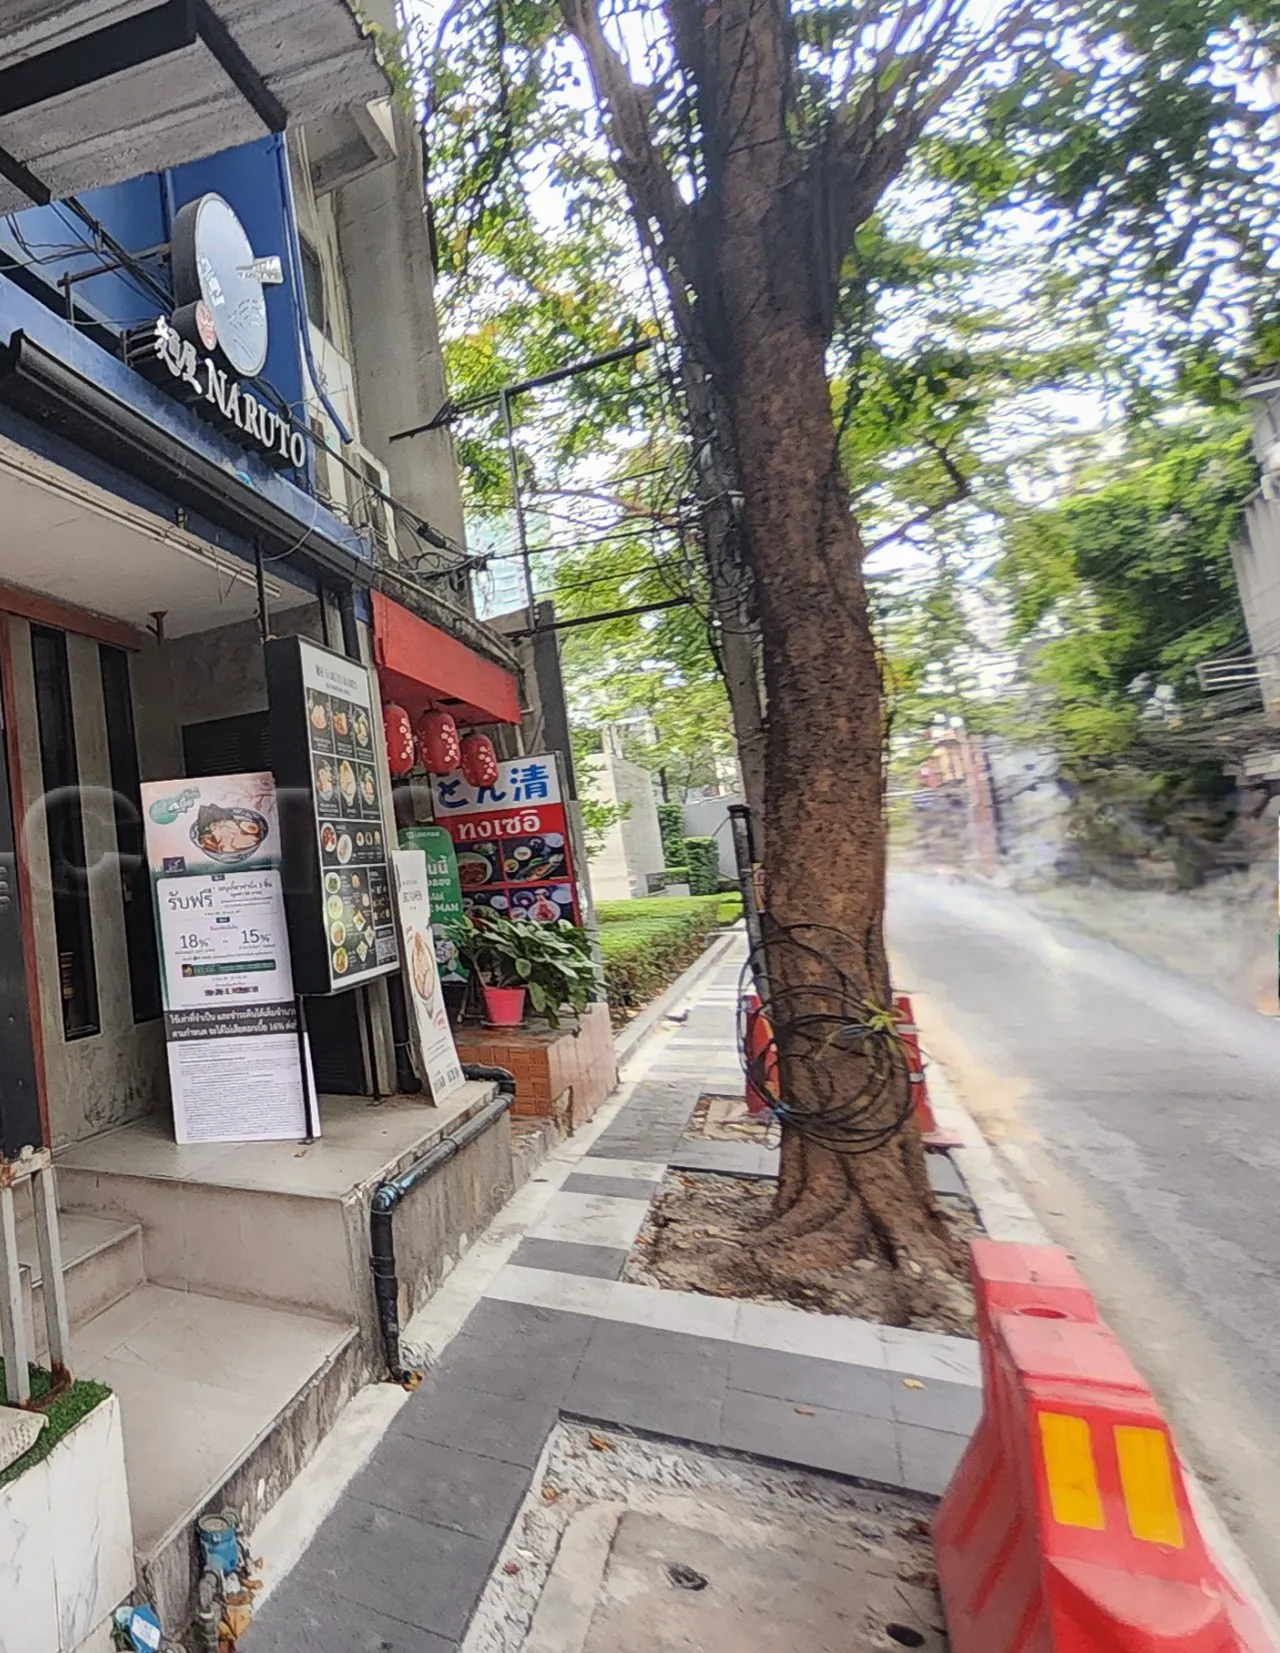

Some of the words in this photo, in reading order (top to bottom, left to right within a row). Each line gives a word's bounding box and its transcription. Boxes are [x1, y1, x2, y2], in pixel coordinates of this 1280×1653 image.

[205, 358, 305, 467] NARUTO
[167, 886, 214, 911] รับฟรี
[179, 933, 211, 950] 18%
[240, 928, 272, 945] 15%
